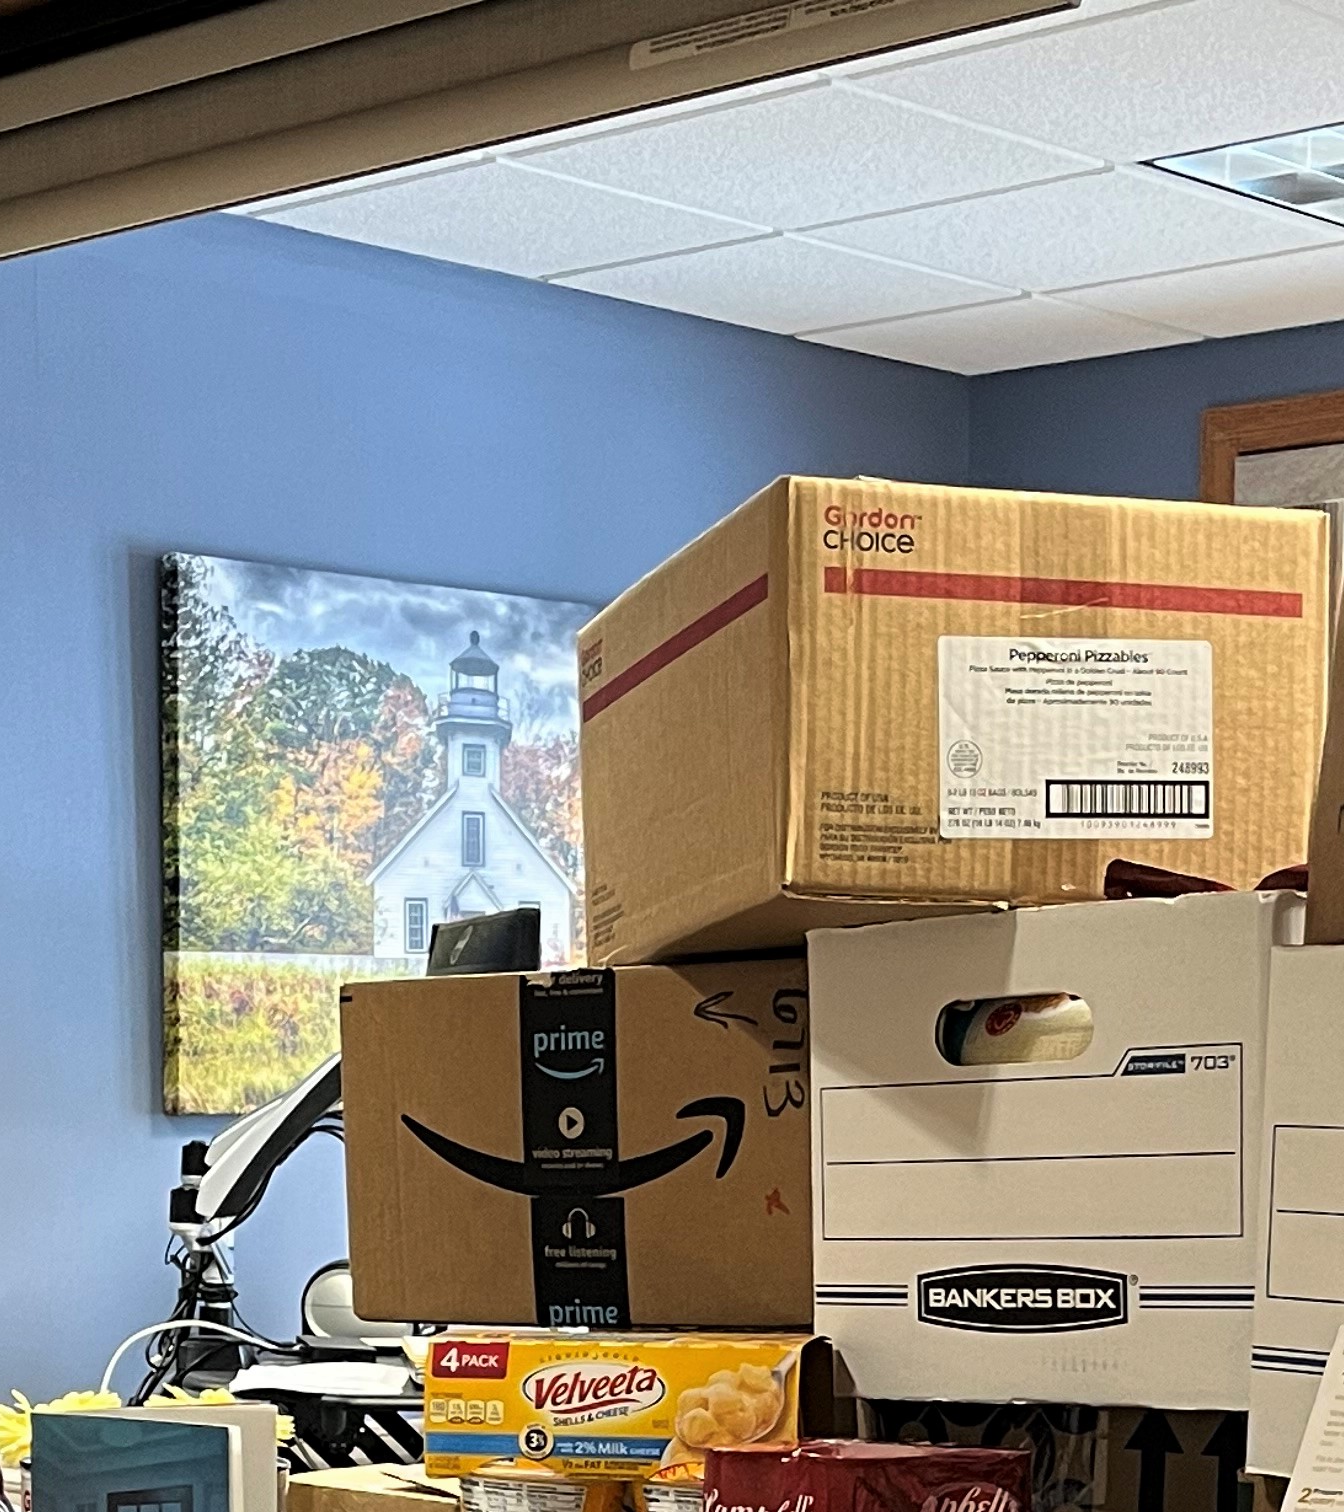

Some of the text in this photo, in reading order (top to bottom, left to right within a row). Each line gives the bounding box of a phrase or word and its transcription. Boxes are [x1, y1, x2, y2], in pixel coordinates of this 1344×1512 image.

[1009, 648, 1149, 665] Pepperoni Pizzables
[533, 1025, 606, 1058] prime
[928, 1287, 1117, 1310] BANKERS BOX
[548, 1299, 619, 1327] prime
[440, 1347, 500, 1373] 4 PACK
[534, 1364, 658, 1410] Velveeta
[552, 1414, 587, 1428] SHELLS
[598, 1441, 629, 1455] Milk
[1297, 1487, 1313, 1504] 2
